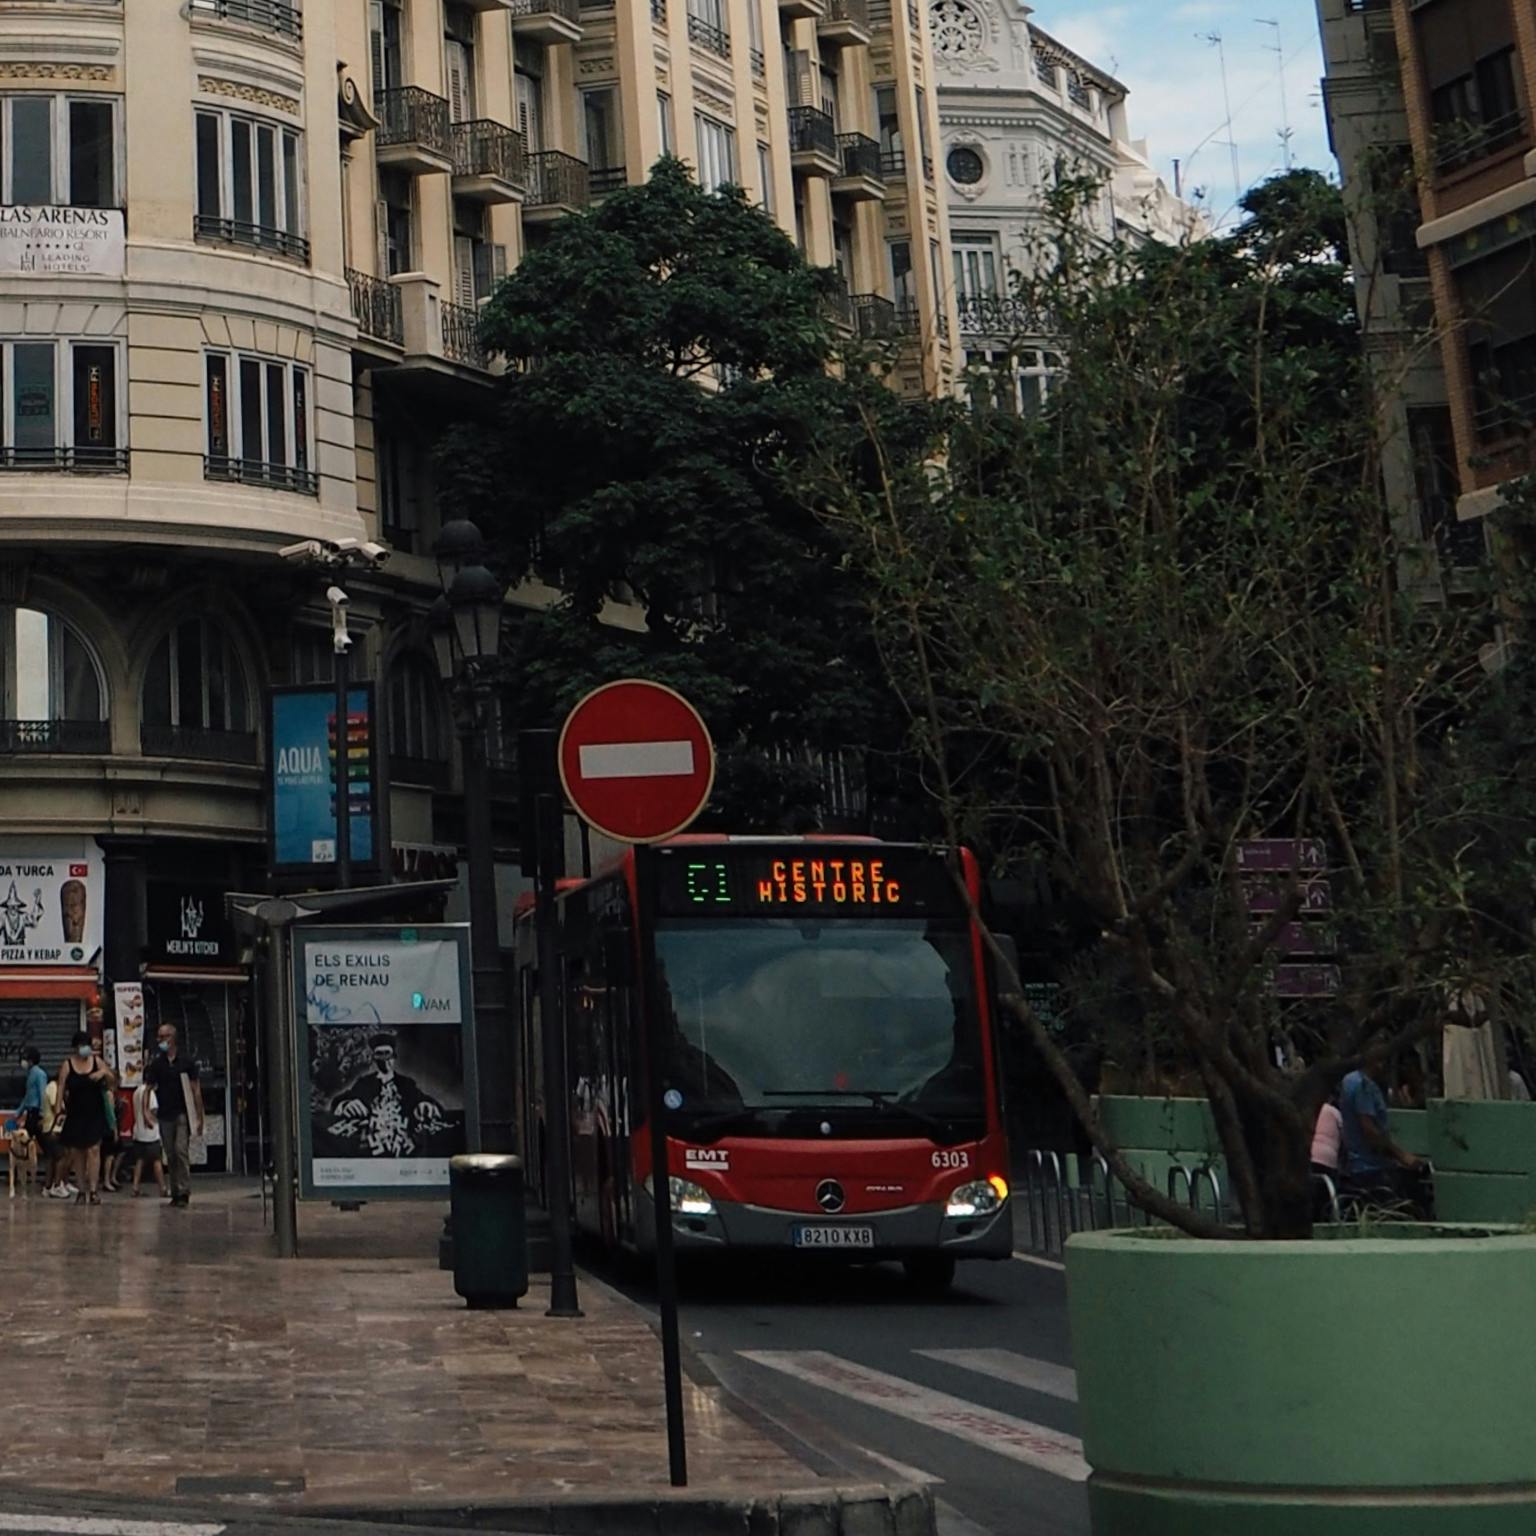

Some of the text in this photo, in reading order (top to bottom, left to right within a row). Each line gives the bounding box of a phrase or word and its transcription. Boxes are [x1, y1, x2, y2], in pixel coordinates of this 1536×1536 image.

[0, 208, 109, 225] LAS ARENAS
[0, 227, 108, 240] BALNEARIO RESORT
[41, 254, 90, 263] LEADING
[277, 747, 322, 774] AQUA
[16, 865, 54, 877] TURCA
[772, 861, 884, 882] CENTRE
[759, 881, 900, 903] HISTORIC
[1, 948, 25, 960] PIZZA
[27, 949, 33, 960] Y
[314, 954, 390, 967] ELS EXILIS
[314, 974, 389, 986] DE RENAU
[685, 1148, 730, 1161] EMT
[931, 1150, 969, 1168] 6303
[804, 1229, 840, 1243] 8210
